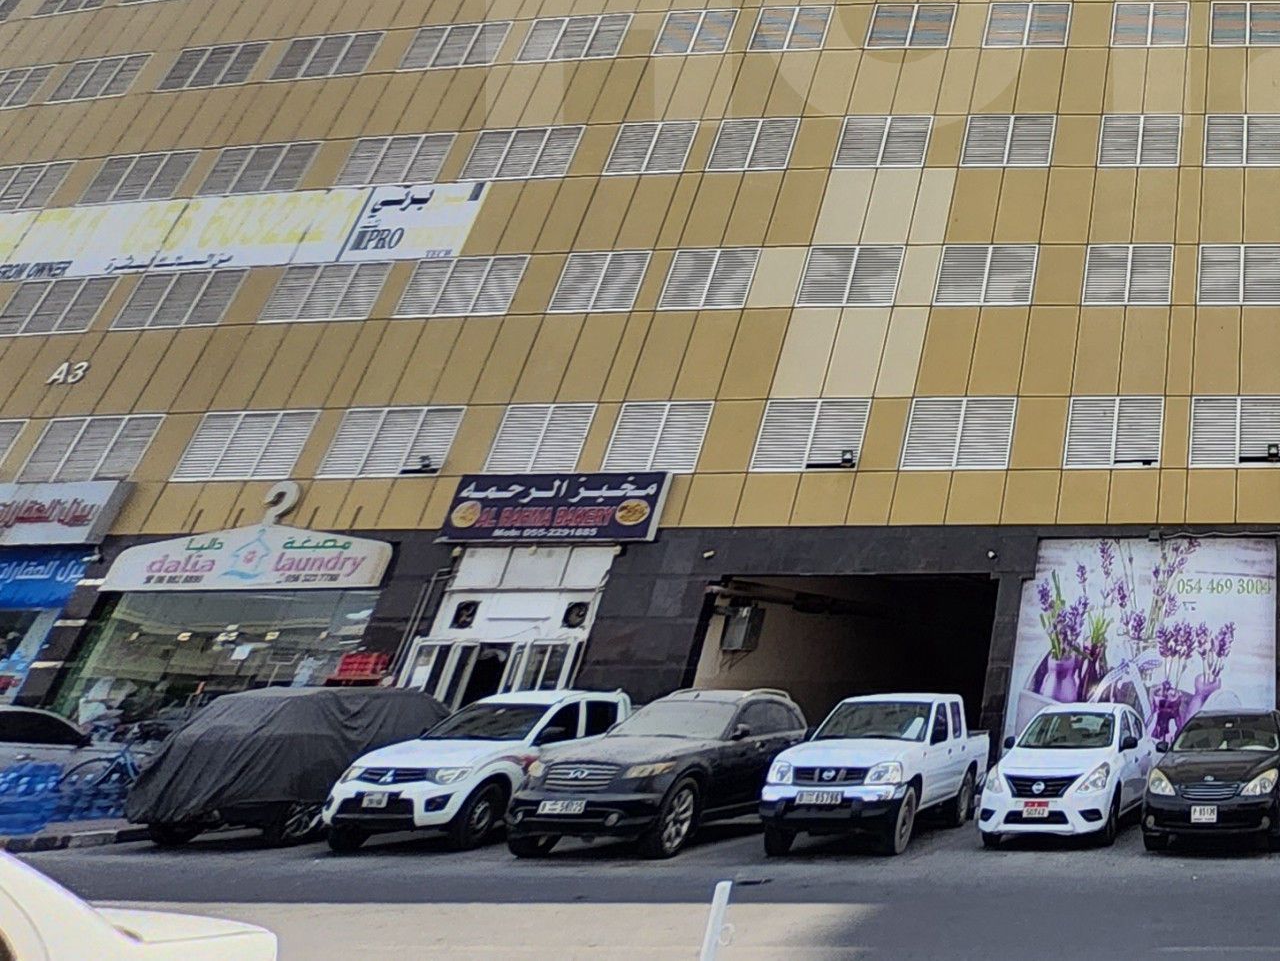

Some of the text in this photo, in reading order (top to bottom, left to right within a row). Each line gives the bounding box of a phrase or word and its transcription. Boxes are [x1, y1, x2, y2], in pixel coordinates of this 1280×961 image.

[46, 360, 89, 385] A3
[568, 476, 657, 503] مخبز
[475, 507, 498, 527] AL
[553, 506, 616, 527] BAKERY
[146, 551, 367, 577] dalia laundry
[1177, 578, 1202, 594] 054
[1206, 578, 1233, 594] 469
